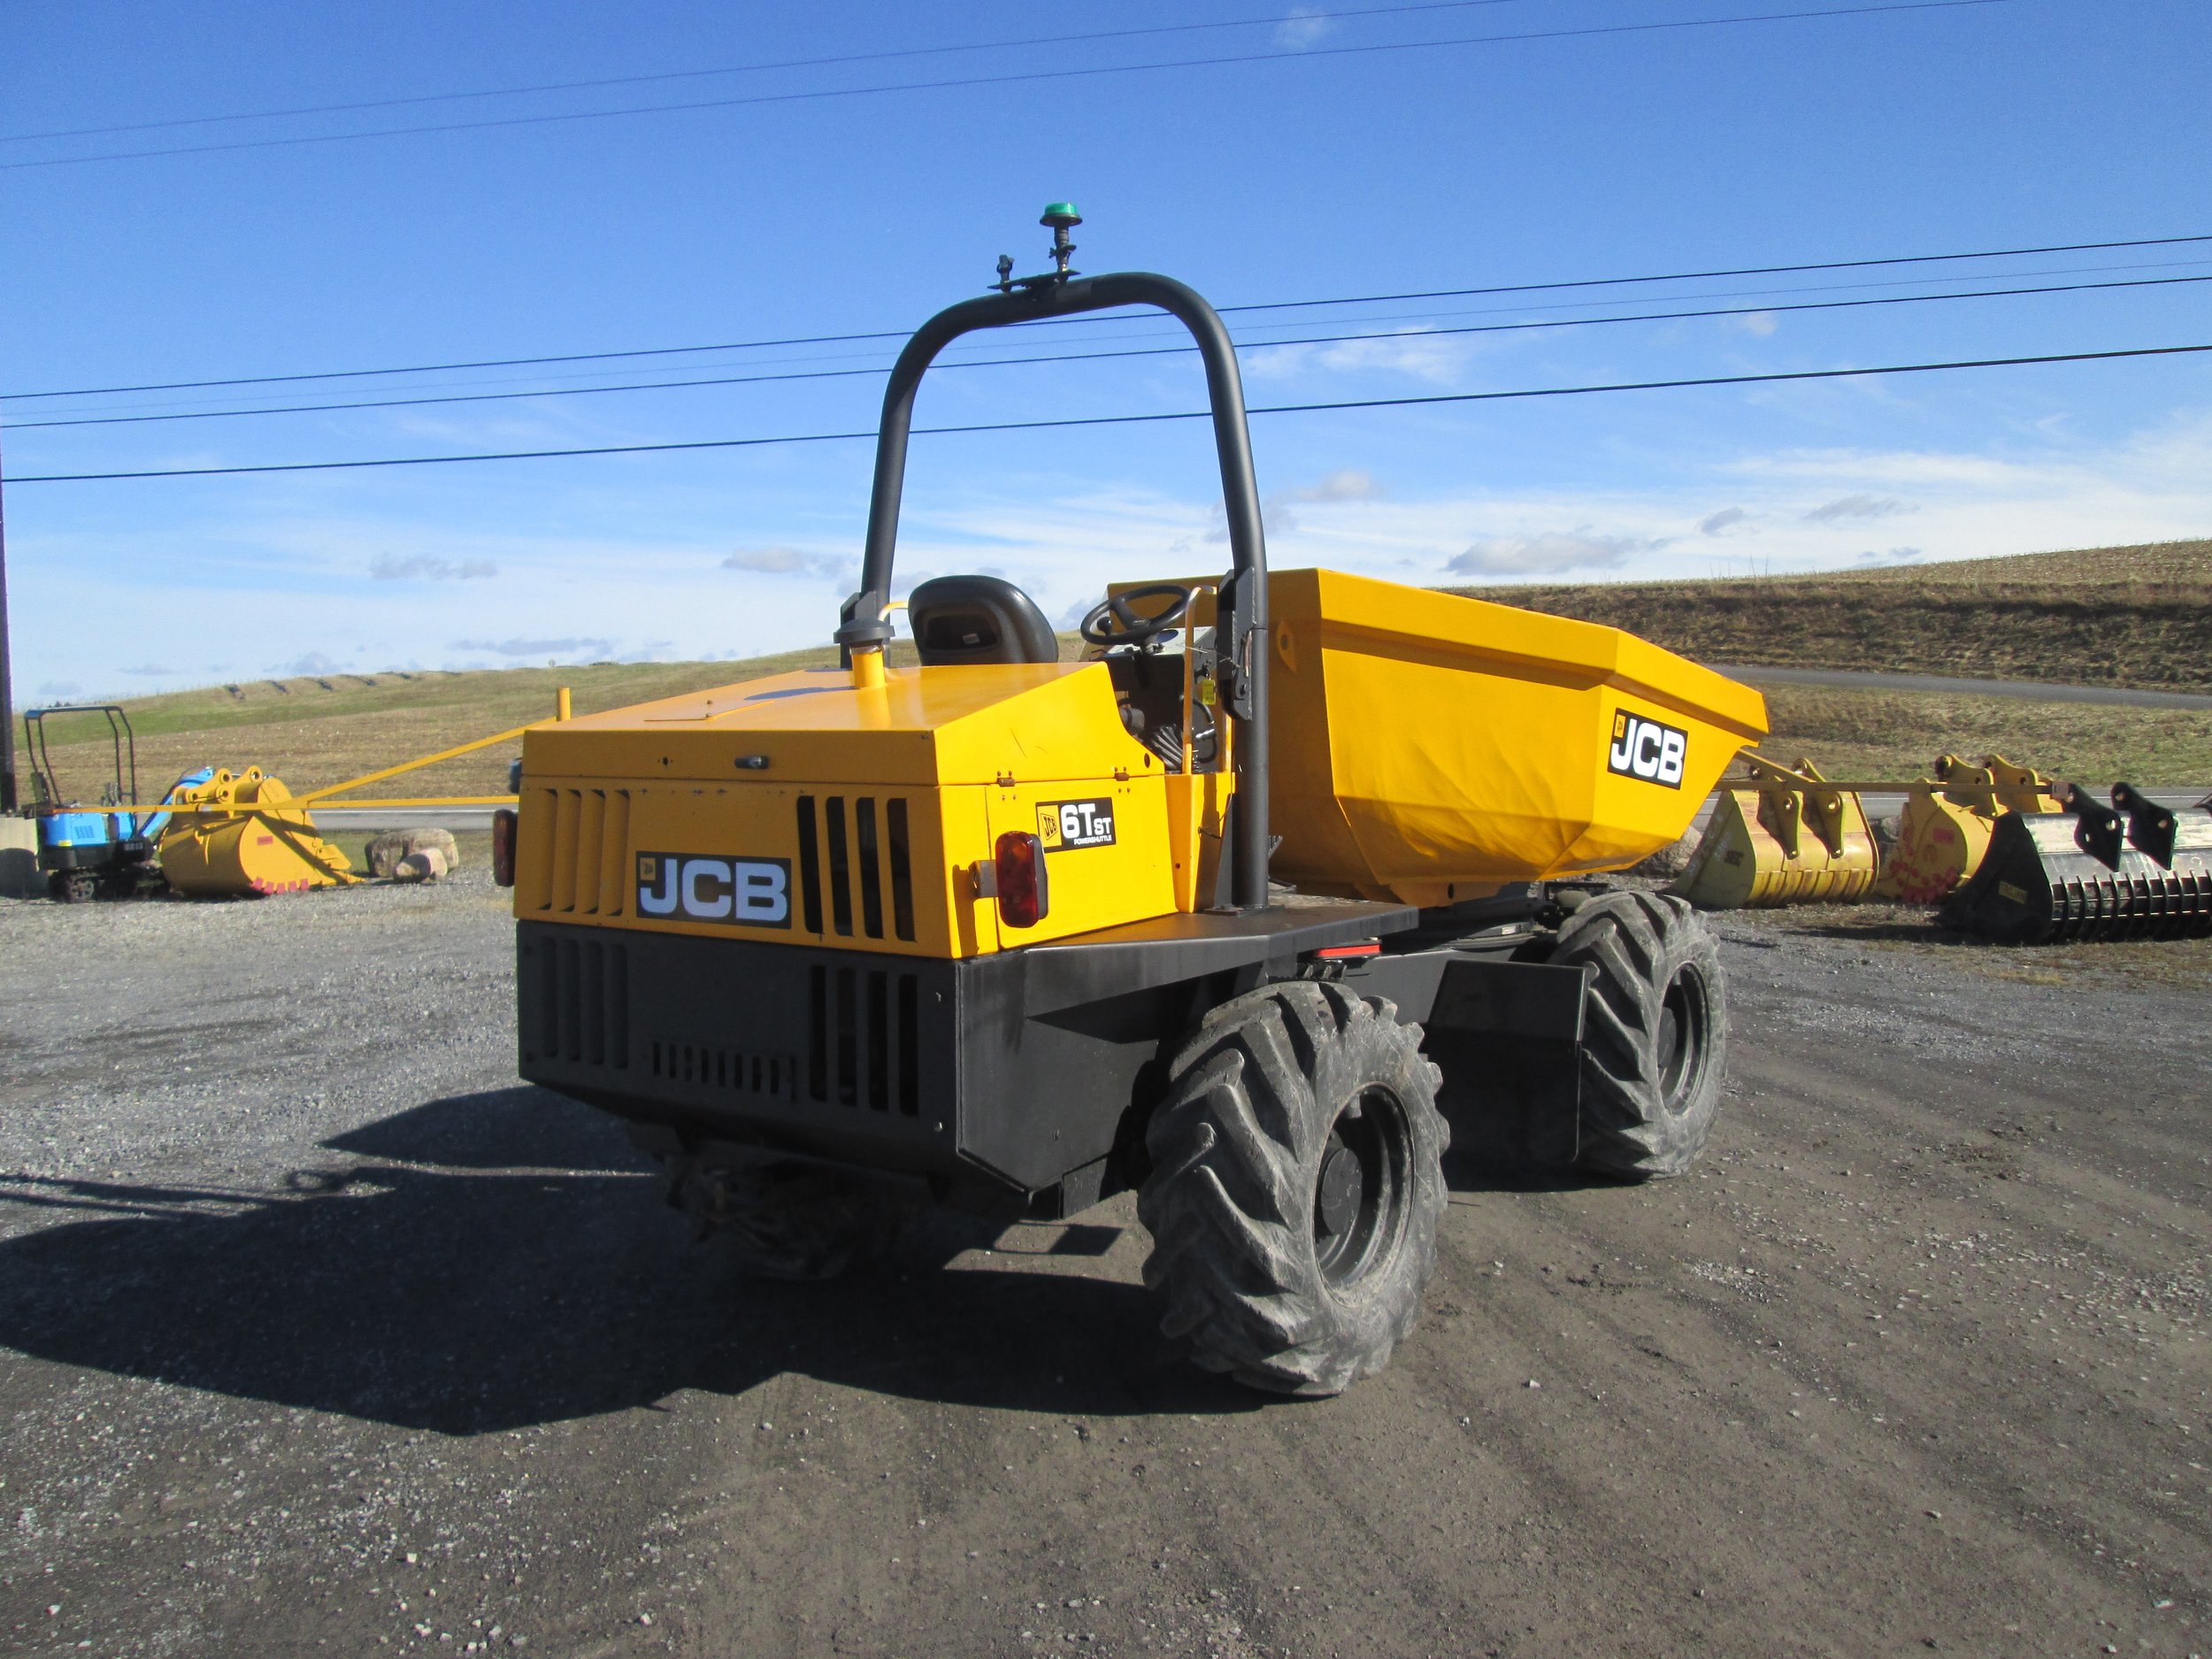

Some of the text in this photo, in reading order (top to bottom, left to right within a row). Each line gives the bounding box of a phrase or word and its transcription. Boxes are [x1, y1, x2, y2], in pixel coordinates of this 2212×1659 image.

[1610, 718, 1685, 784] JCB
[1073, 834, 1112, 846] POWERSHUTTLE
[640, 858, 787, 921] JCB
